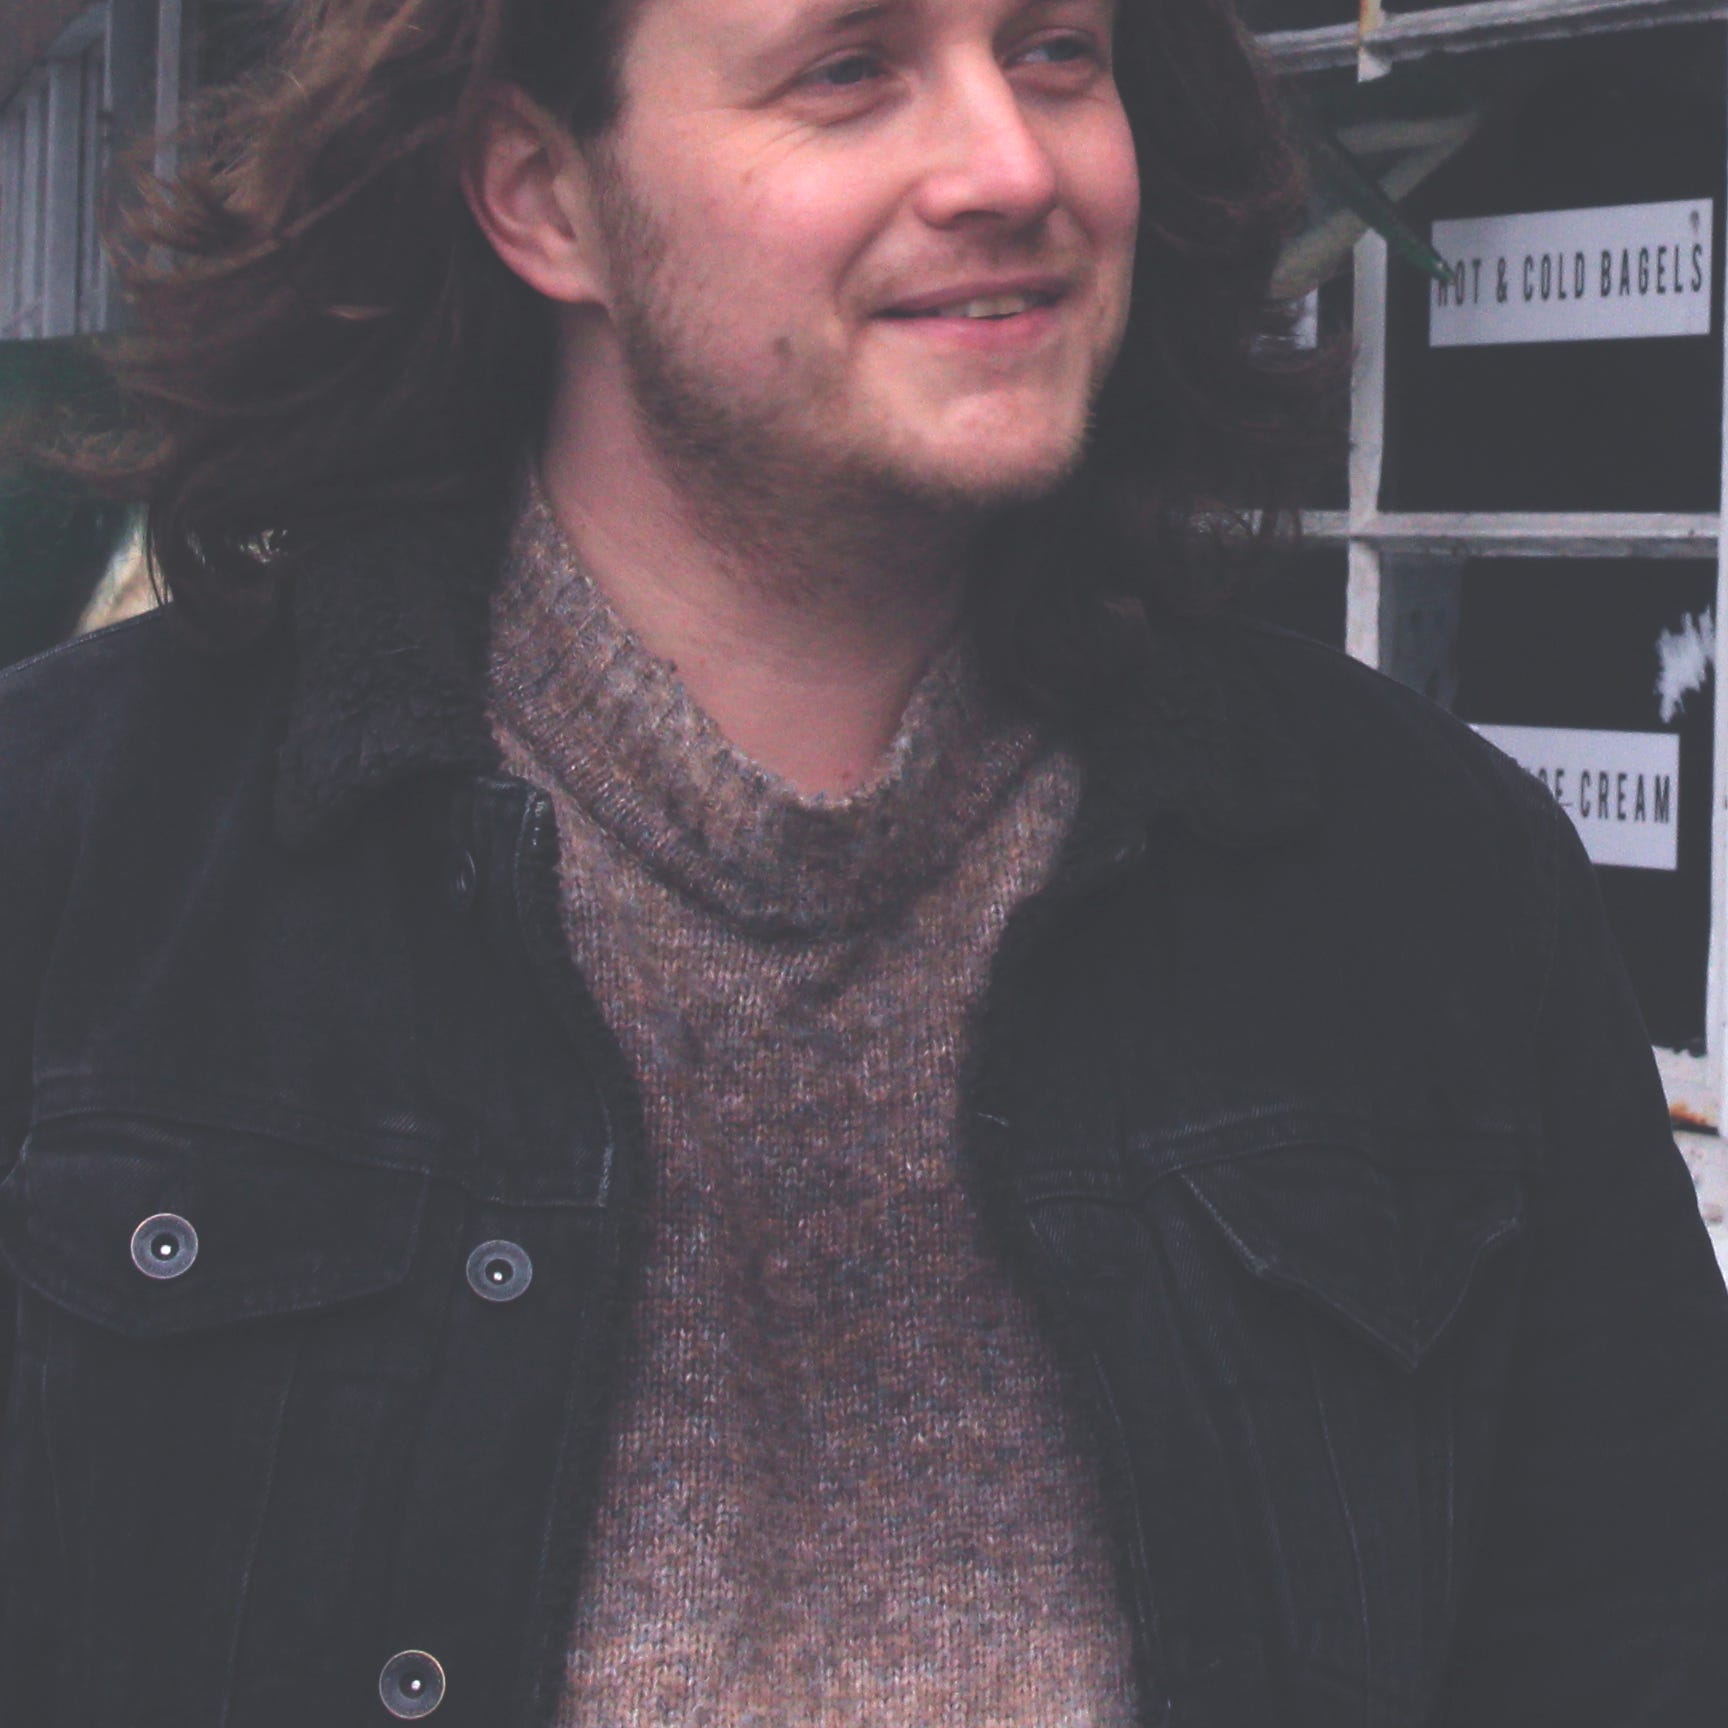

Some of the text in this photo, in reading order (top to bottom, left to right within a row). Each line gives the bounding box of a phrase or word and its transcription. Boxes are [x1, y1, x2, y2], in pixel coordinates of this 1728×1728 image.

[1496, 256, 1509, 304] &
[1523, 250, 1586, 302] COLD
[1600, 243, 1703, 298] BAGELS
[1579, 768, 1671, 824] CREAM
